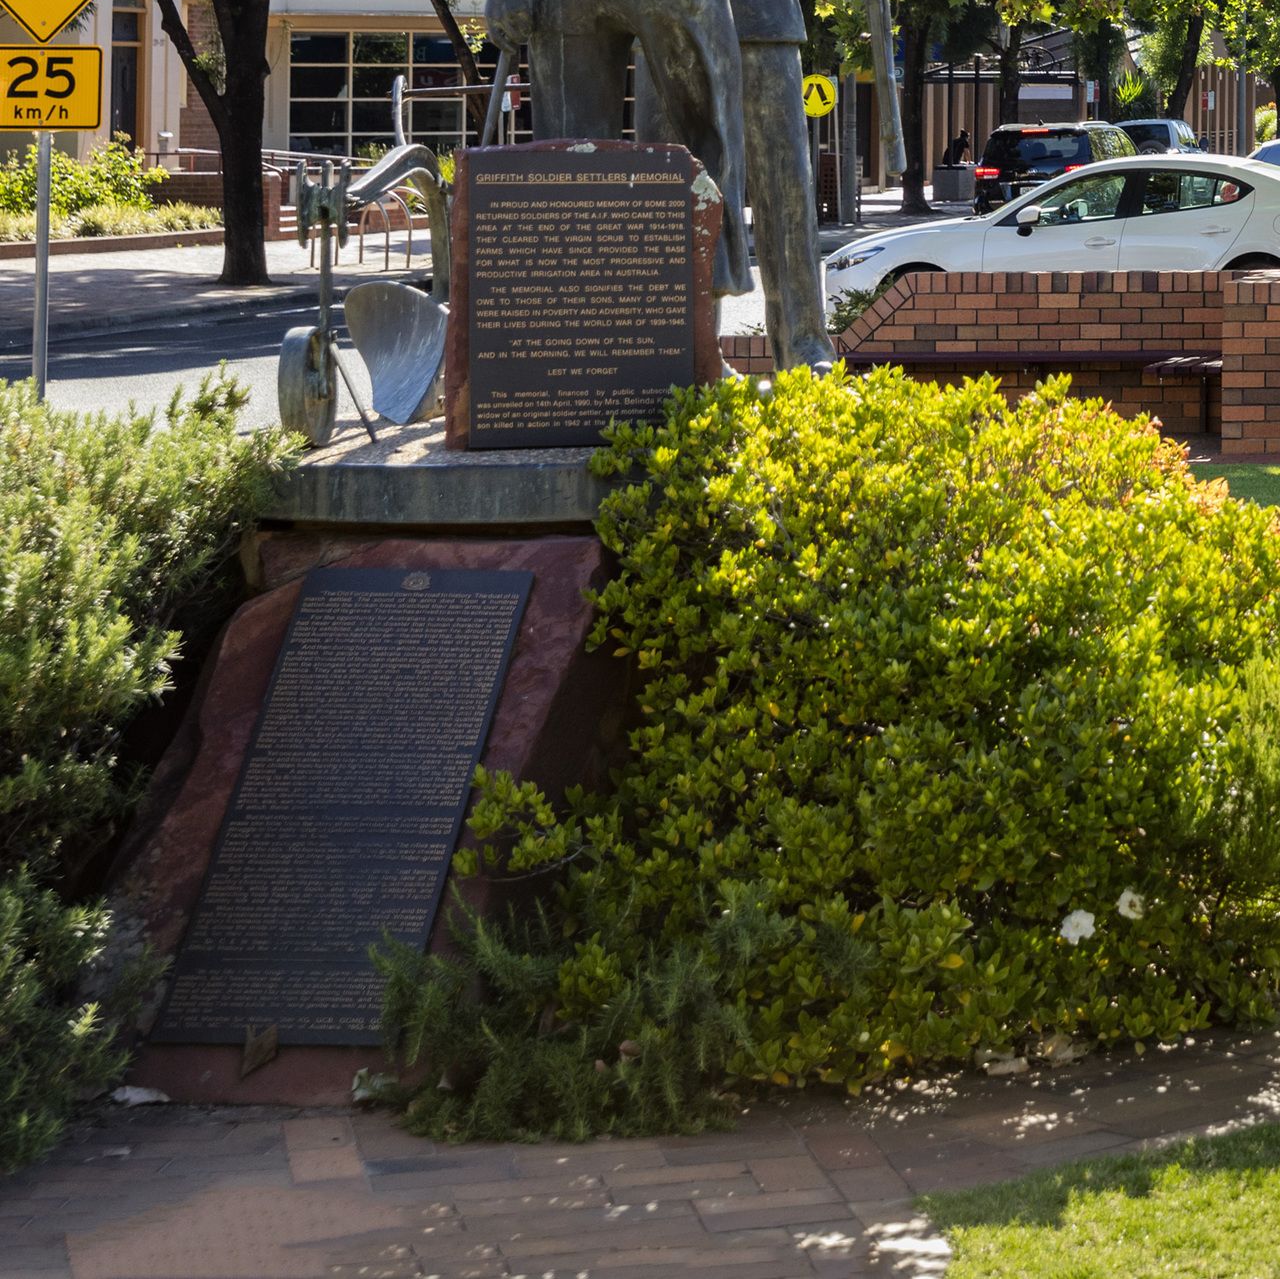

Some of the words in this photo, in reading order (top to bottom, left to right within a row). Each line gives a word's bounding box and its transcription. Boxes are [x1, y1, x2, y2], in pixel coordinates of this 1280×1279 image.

[7, 56, 75, 98] 25
[14, 105, 68, 120] km/h
[476, 173, 523, 181] GRIFFITH
[528, 173, 572, 181] SOLDIER
[576, 173, 627, 181] SETTLERS
[630, 173, 684, 181] MEMORIAL
[476, 270, 527, 278] PRODUCTIVE
[529, 320, 561, 328] DURING
[583, 319, 612, 327] WORLD
